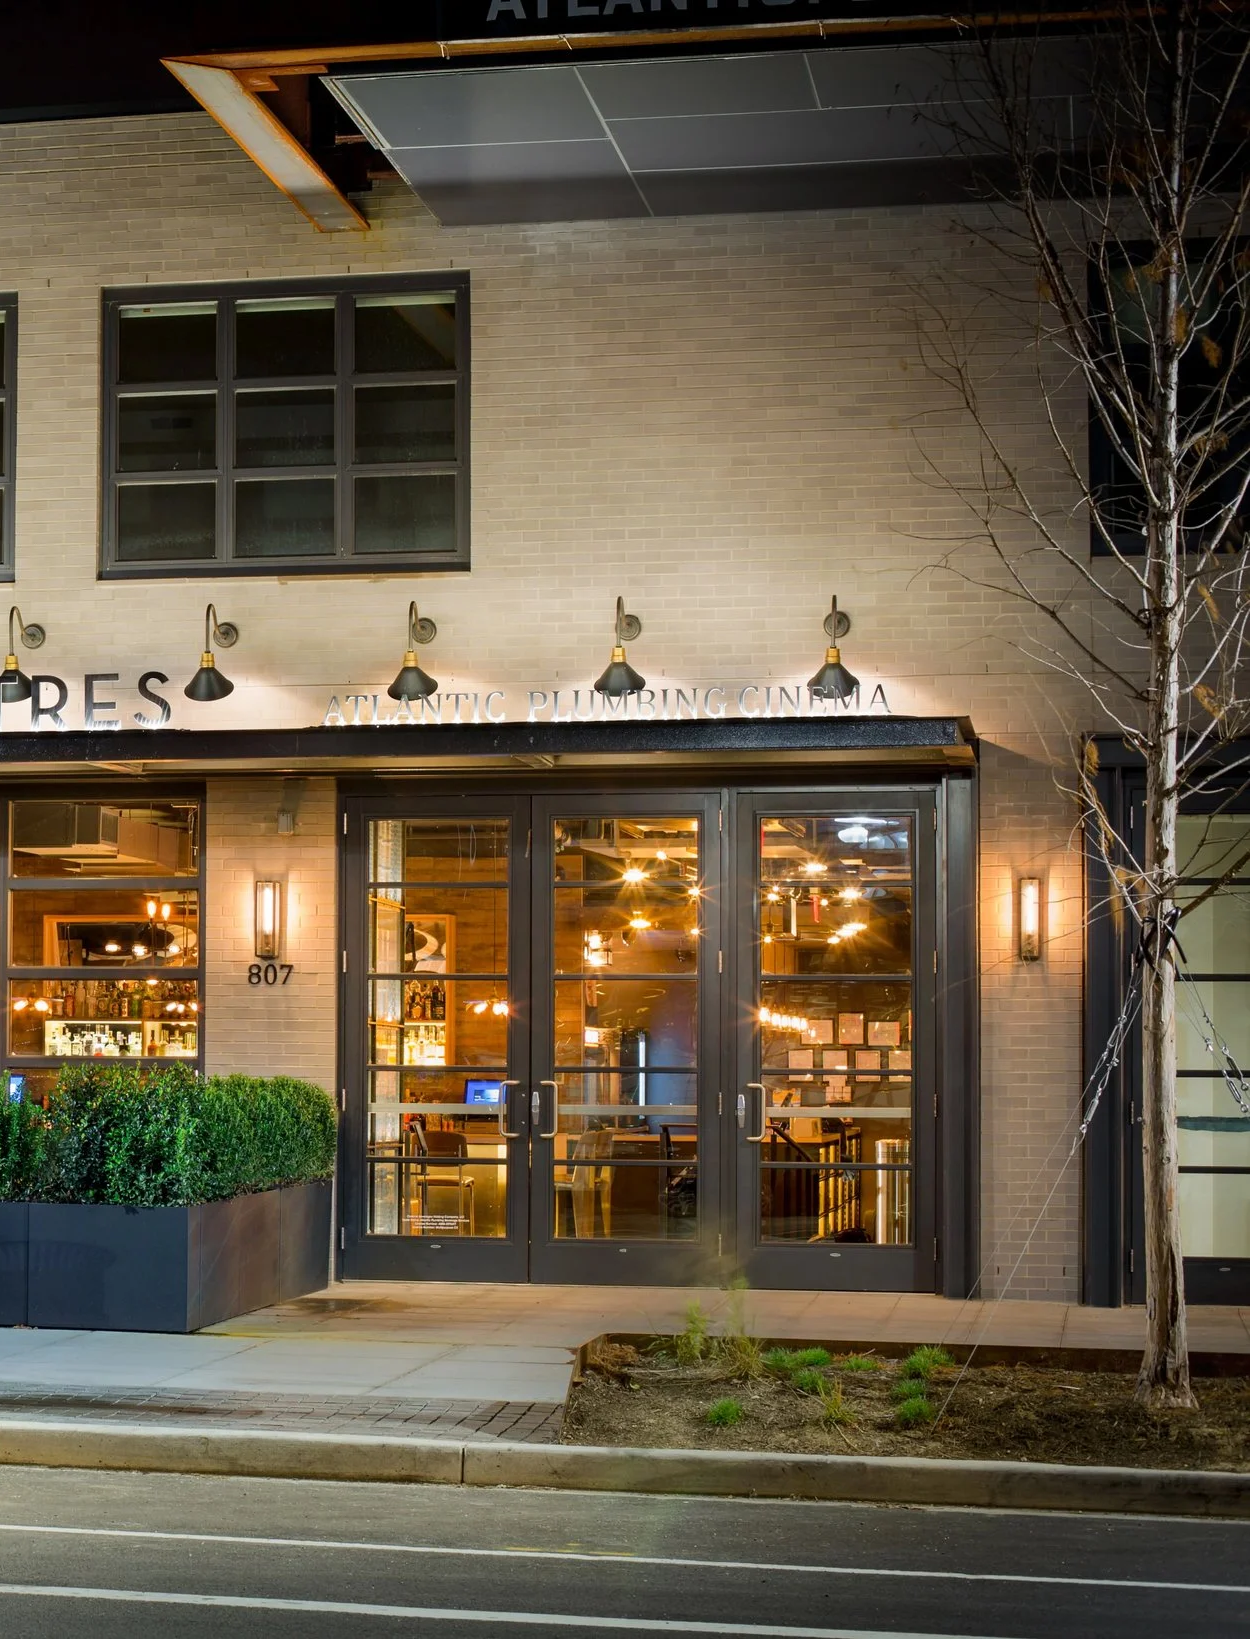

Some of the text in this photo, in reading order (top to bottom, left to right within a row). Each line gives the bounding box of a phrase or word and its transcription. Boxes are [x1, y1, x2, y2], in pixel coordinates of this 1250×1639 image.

[322, 683, 893, 726] ATLANTIC PLUMBING CINEMA
[248, 963, 294, 985] 807
